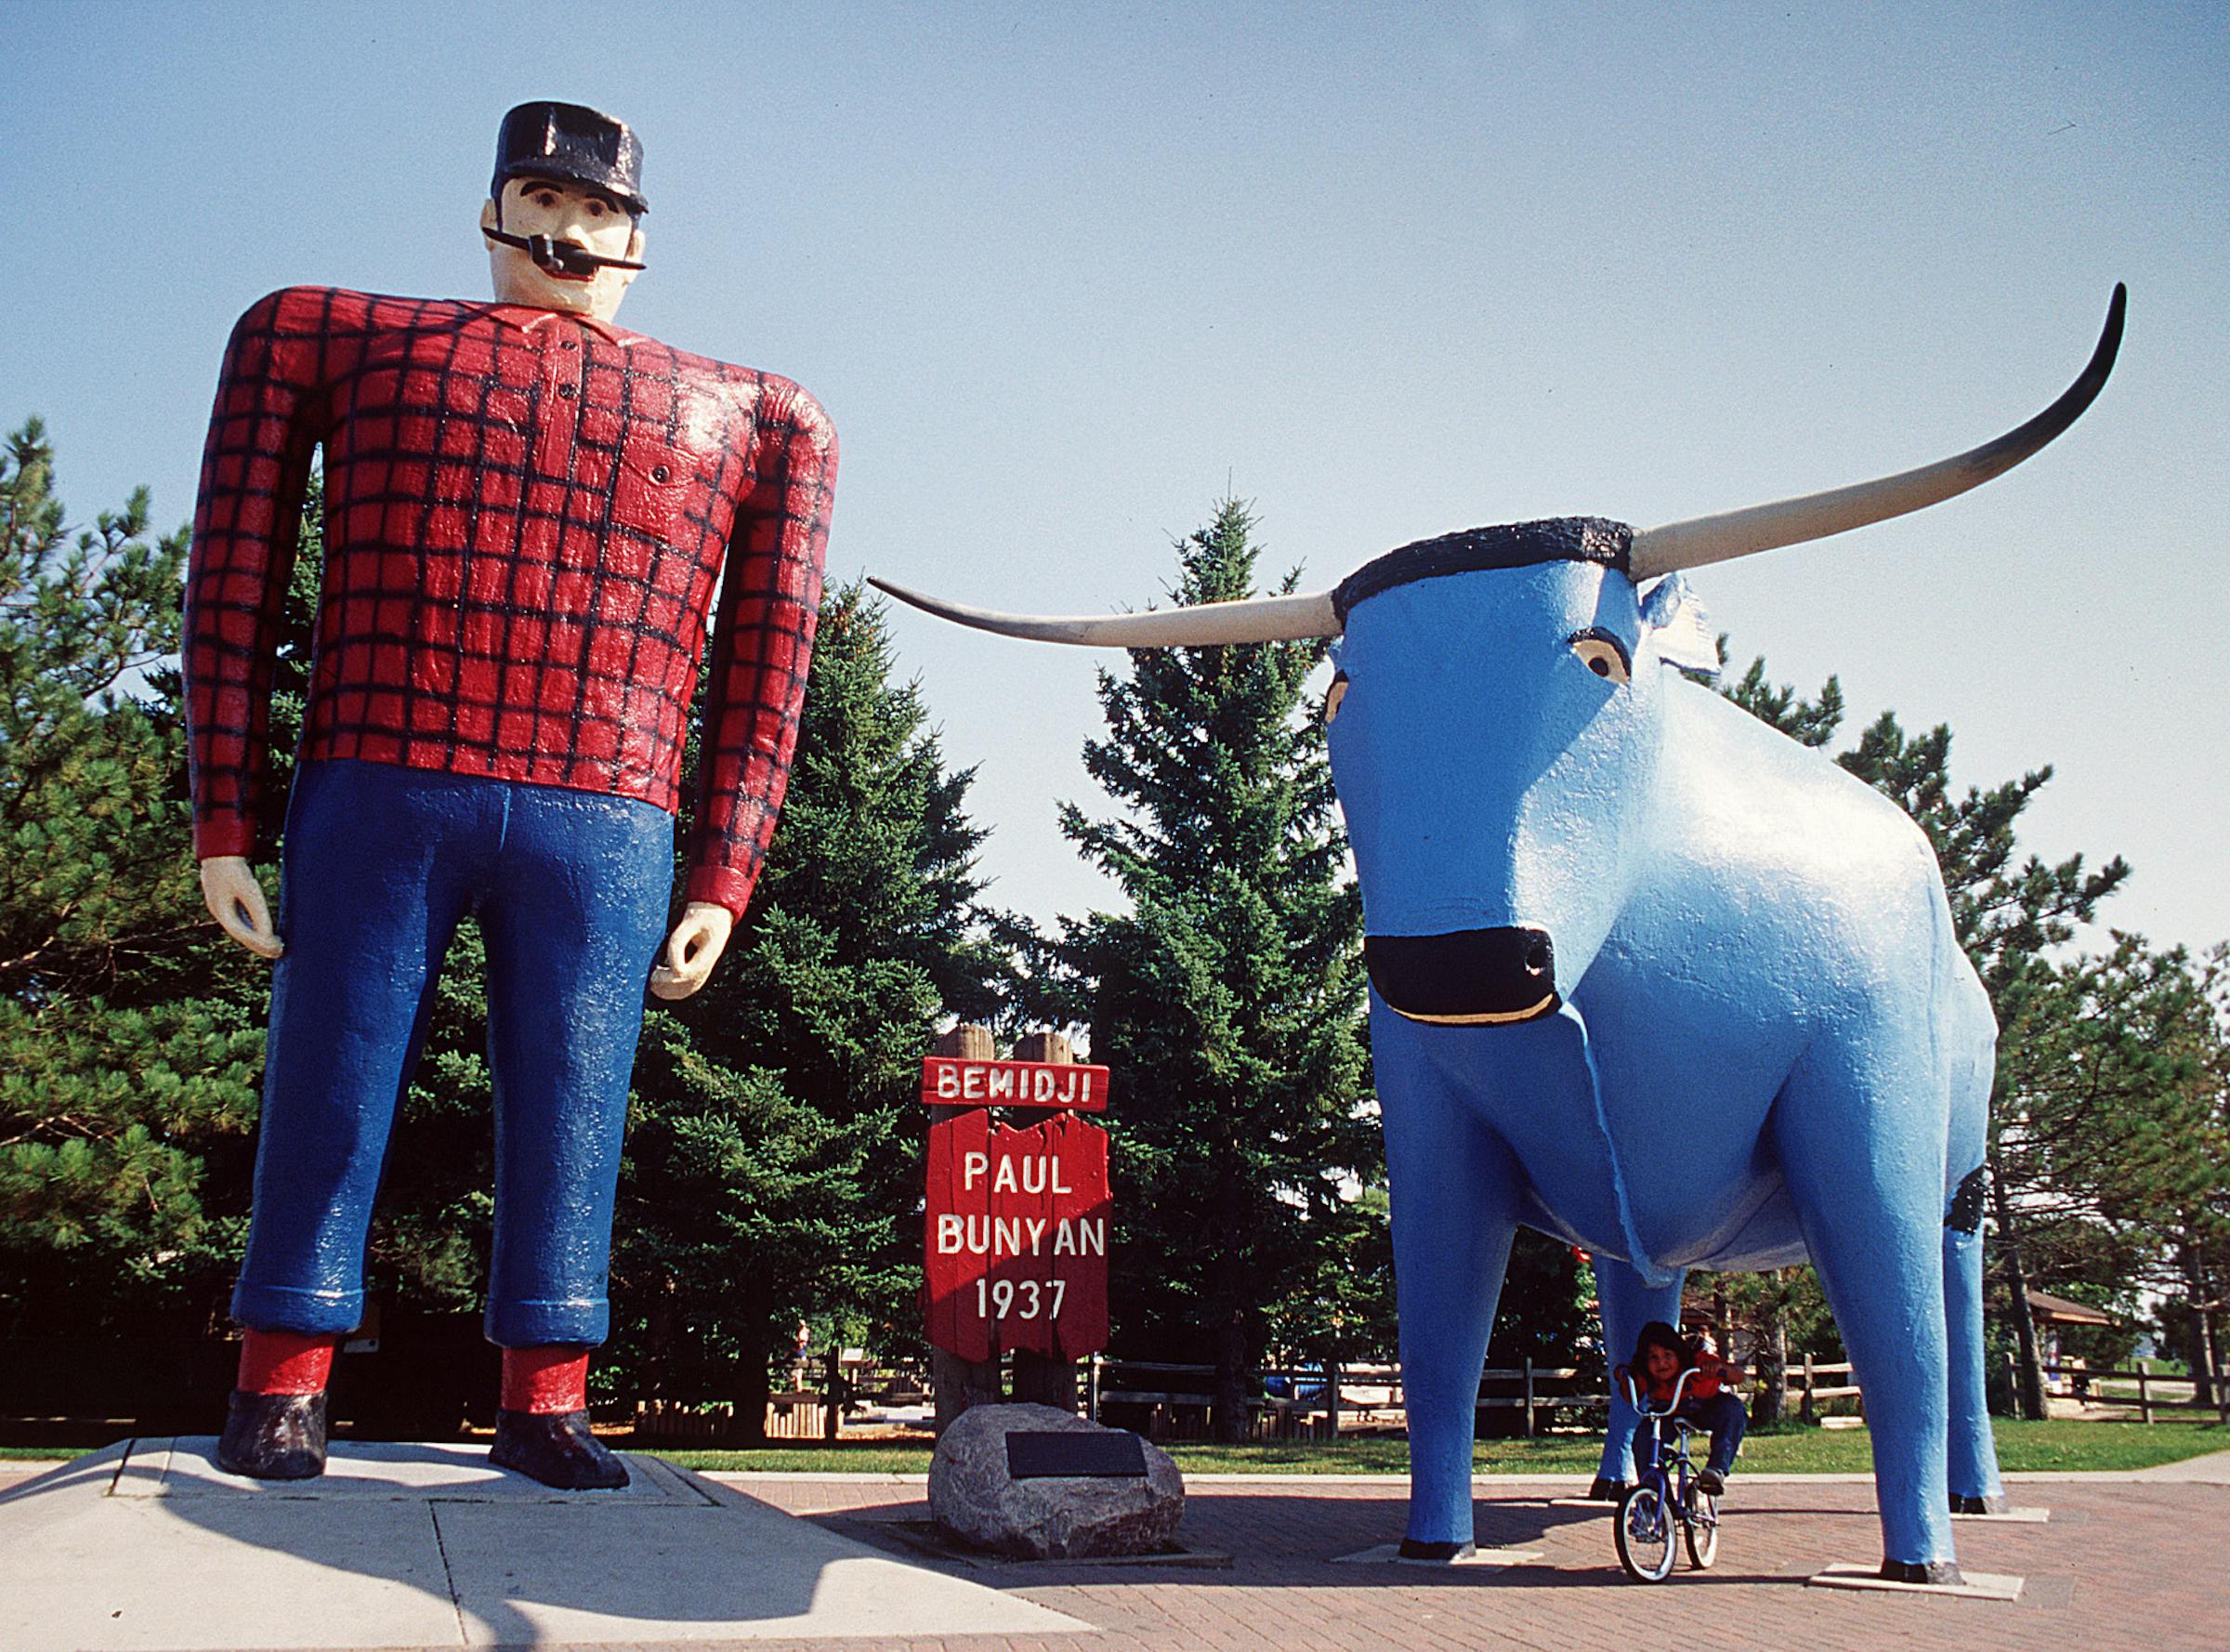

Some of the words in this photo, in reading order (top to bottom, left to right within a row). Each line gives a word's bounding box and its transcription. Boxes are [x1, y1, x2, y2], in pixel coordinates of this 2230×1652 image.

[937, 1064, 1092, 1103] BEMIDJI
[964, 1151, 1072, 1194] PAUL
[937, 1213, 1105, 1256] BUNYAN
[976, 1278, 1067, 1320] 1937
